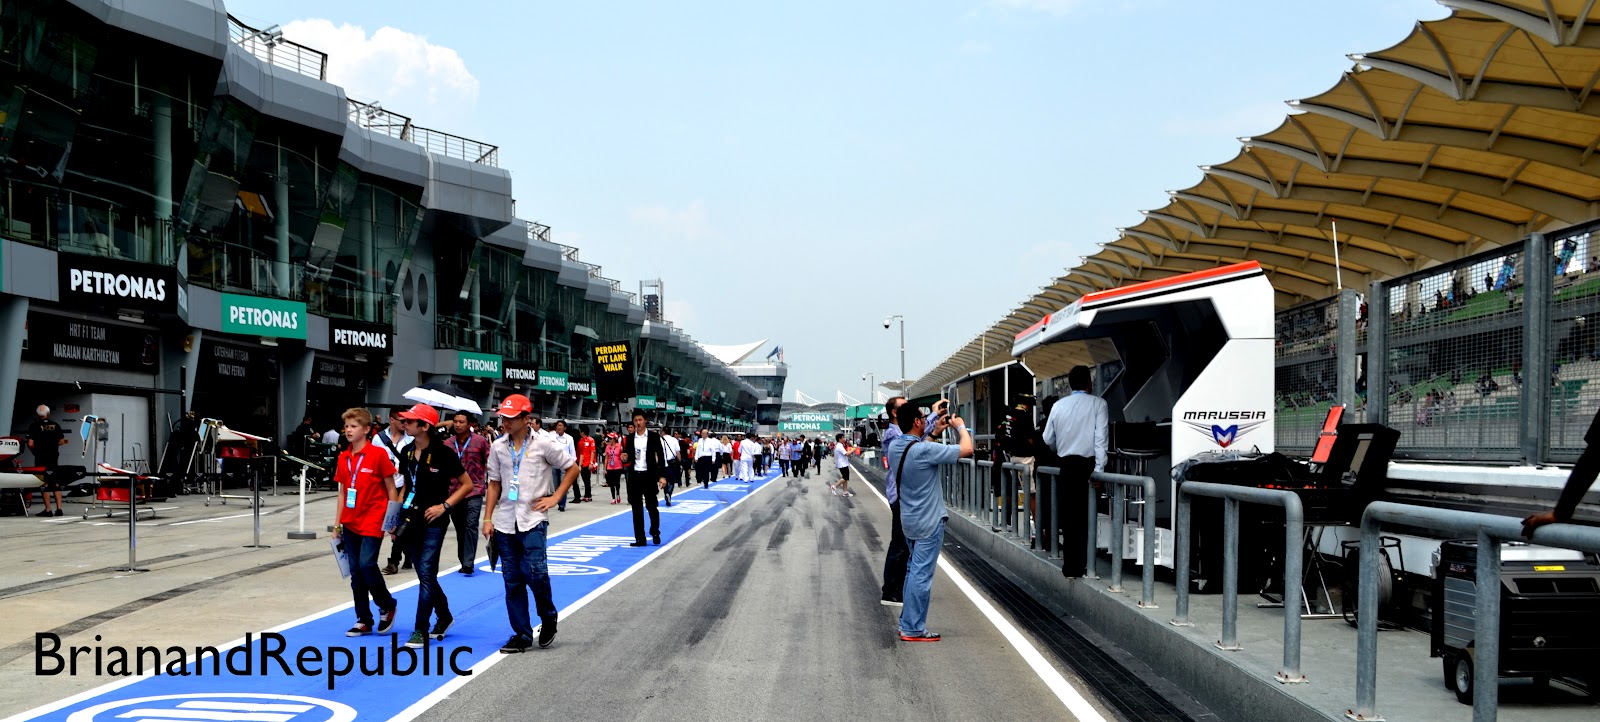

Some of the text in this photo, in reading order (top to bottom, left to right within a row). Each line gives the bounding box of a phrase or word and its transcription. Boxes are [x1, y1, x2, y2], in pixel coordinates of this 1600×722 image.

[70, 268, 166, 302] PETRONAS
[230, 305, 298, 330] PETRONAS
[69, 323, 106, 341] HRT F1 TEAM
[334, 328, 387, 349] PETRONAS
[53, 342, 120, 364] NARAIAN KARTHIKEYAN
[595, 343, 628, 356] PERDANA
[597, 353, 627, 364] PIT LANE
[463, 358, 498, 373] PETRONAS
[603, 362, 624, 373] WALK
[505, 367, 536, 381] PETRONAS
[539, 376, 566, 388] PETRONAS
[567, 381, 590, 393] PETRONAS
[793, 414, 830, 422] PETRONAS
[1183, 411, 1266, 420] MARUSSIA
[783, 422, 821, 430] PETRONAS
